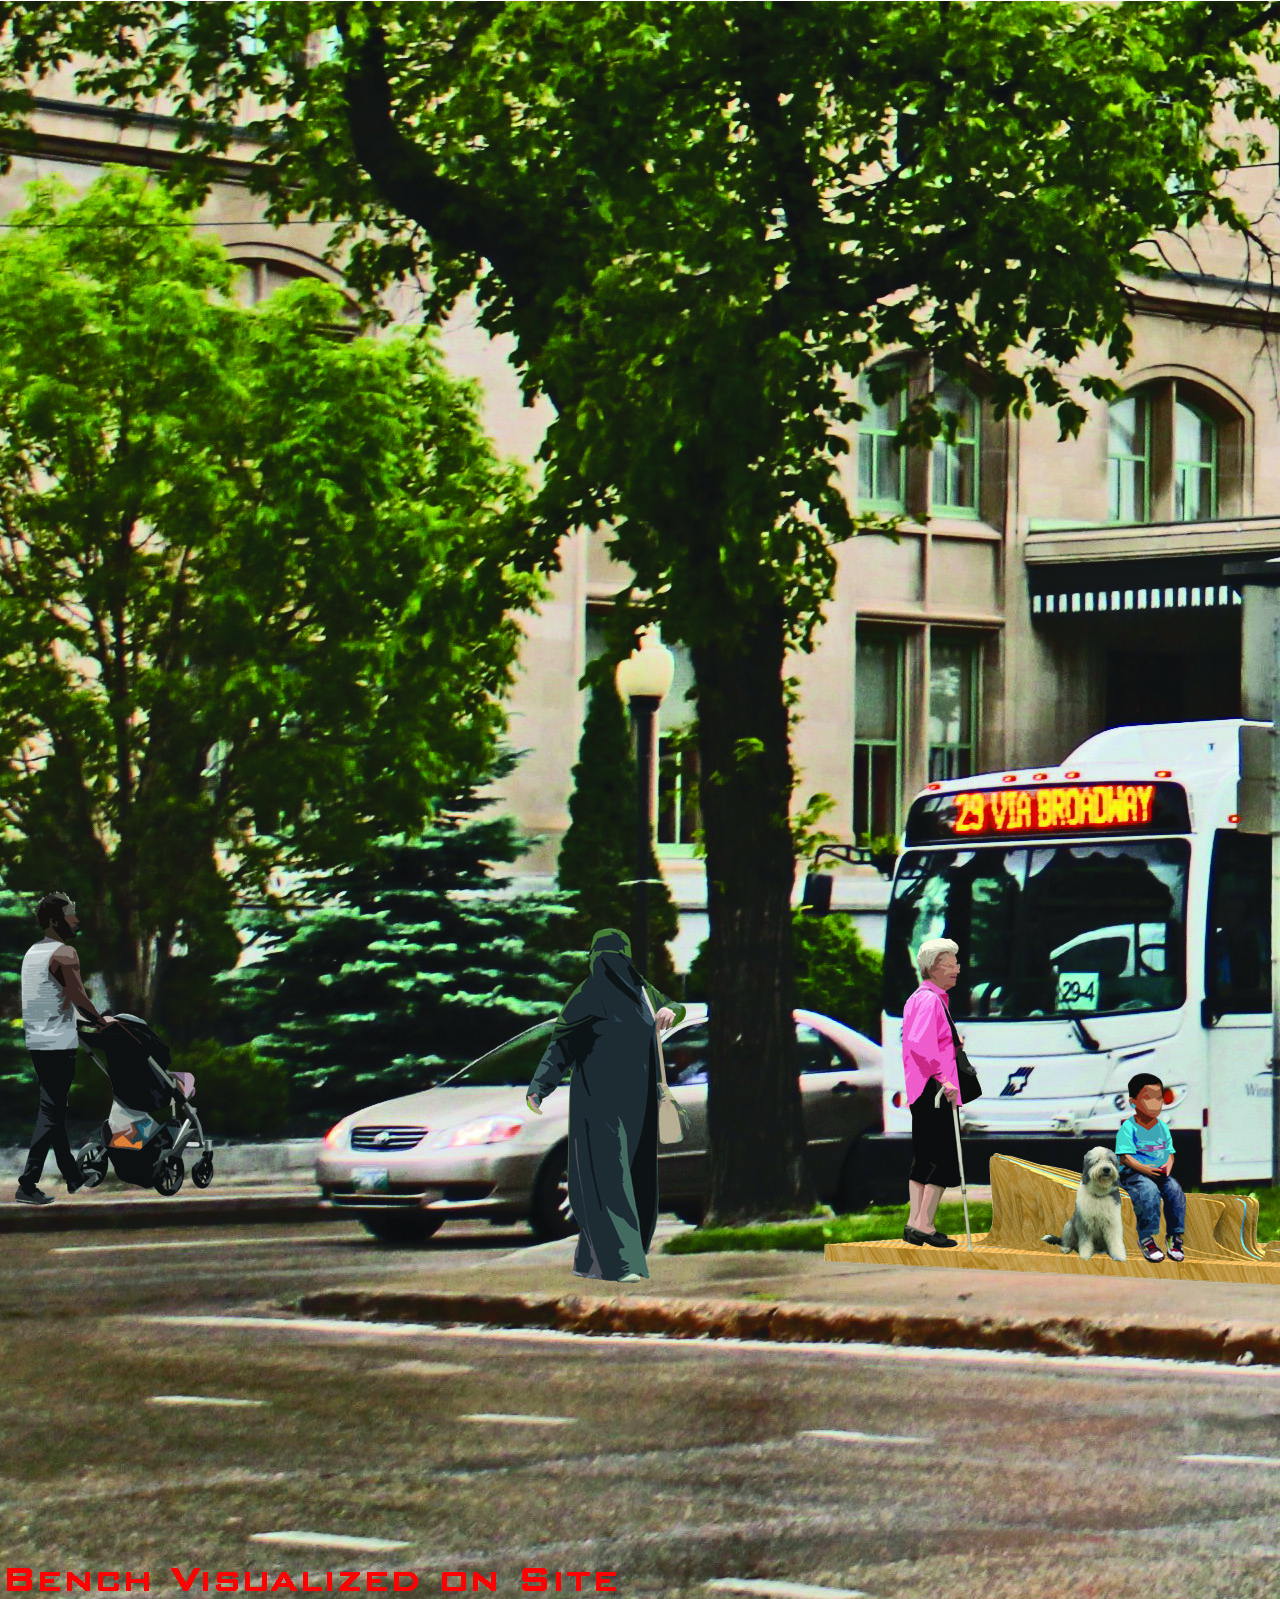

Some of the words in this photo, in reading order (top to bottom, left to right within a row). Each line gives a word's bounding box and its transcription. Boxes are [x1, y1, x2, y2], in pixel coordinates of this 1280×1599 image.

[954, 792, 985, 832] 29
[990, 790, 1031, 830] VIA
[1035, 784, 1155, 829] BROADWAY
[1060, 980, 1095, 1003] 29-4
